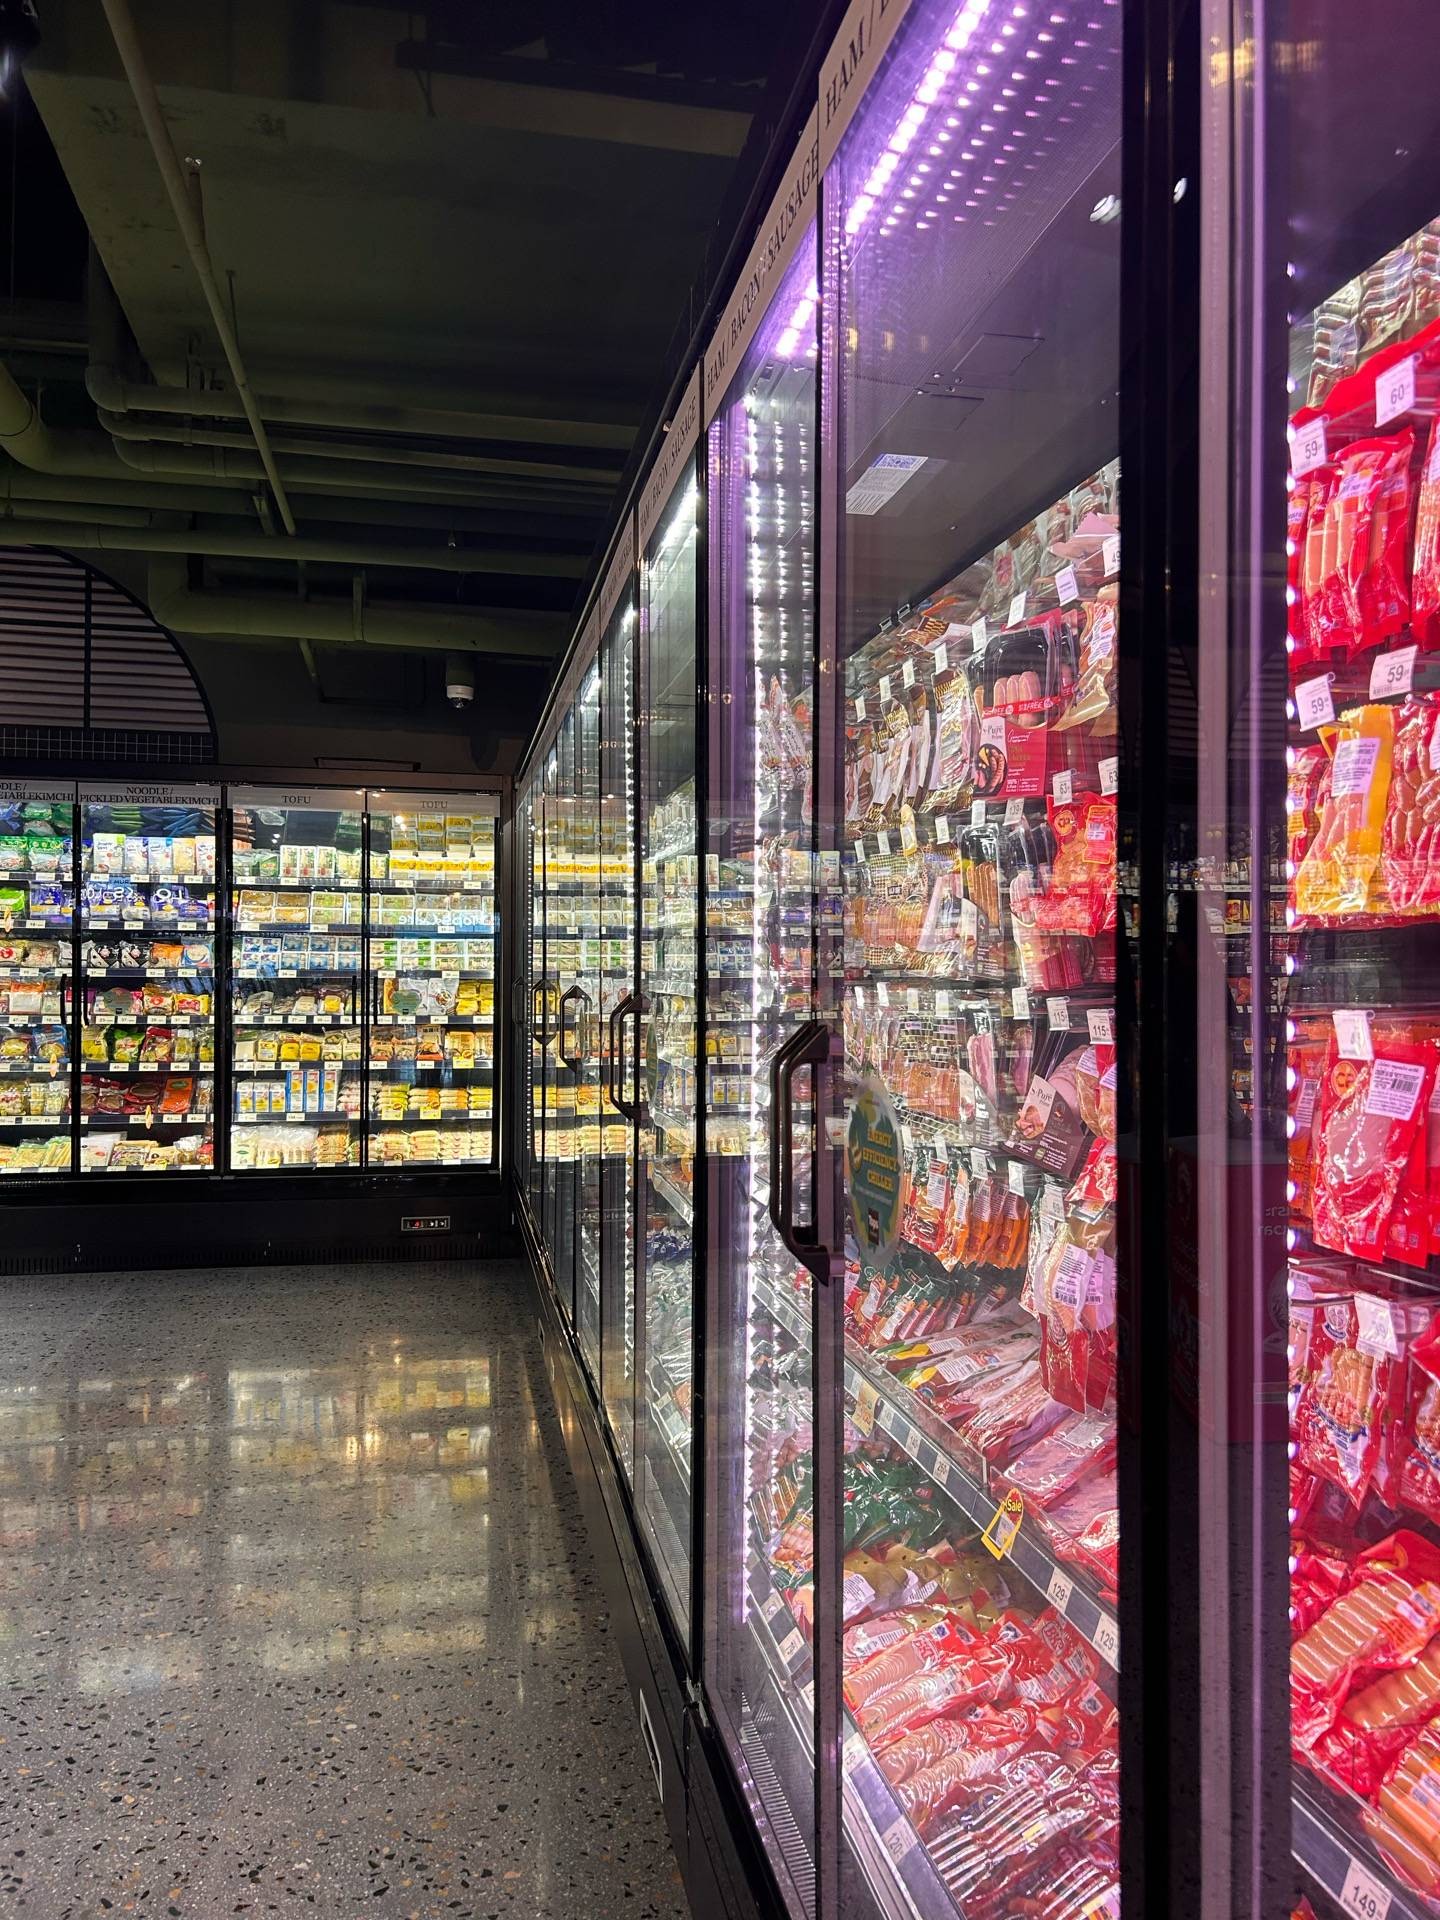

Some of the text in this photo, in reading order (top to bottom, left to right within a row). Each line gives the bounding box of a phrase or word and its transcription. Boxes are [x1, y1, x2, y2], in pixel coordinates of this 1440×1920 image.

[826, 16, 864, 130] HAM
[707, 342, 727, 399] HAM
[767, 141, 818, 272] SAUSAGE
[1390, 384, 1405, 404] 60
[1305, 440, 1318, 460] 59
[1387, 664, 1404, 683] 59
[1311, 697, 1324, 714] 59
[0, 783, 22, 791] DLE
[127, 786, 169, 795] NOODLE
[80, 794, 123, 803] PICKLED
[281, 796, 311, 804] TOFU
[420, 800, 448, 809] TOFU
[1053, 1011, 1065, 1022] 115
[1093, 1024, 1107, 1037] 115
[1006, 1499, 1022, 1512] Sale
[1053, 1582, 1066, 1601] 129
[1100, 1629, 1115, 1650] 129
[888, 1832, 903, 1856] 120
[1352, 1885, 1377, 1919] 149
